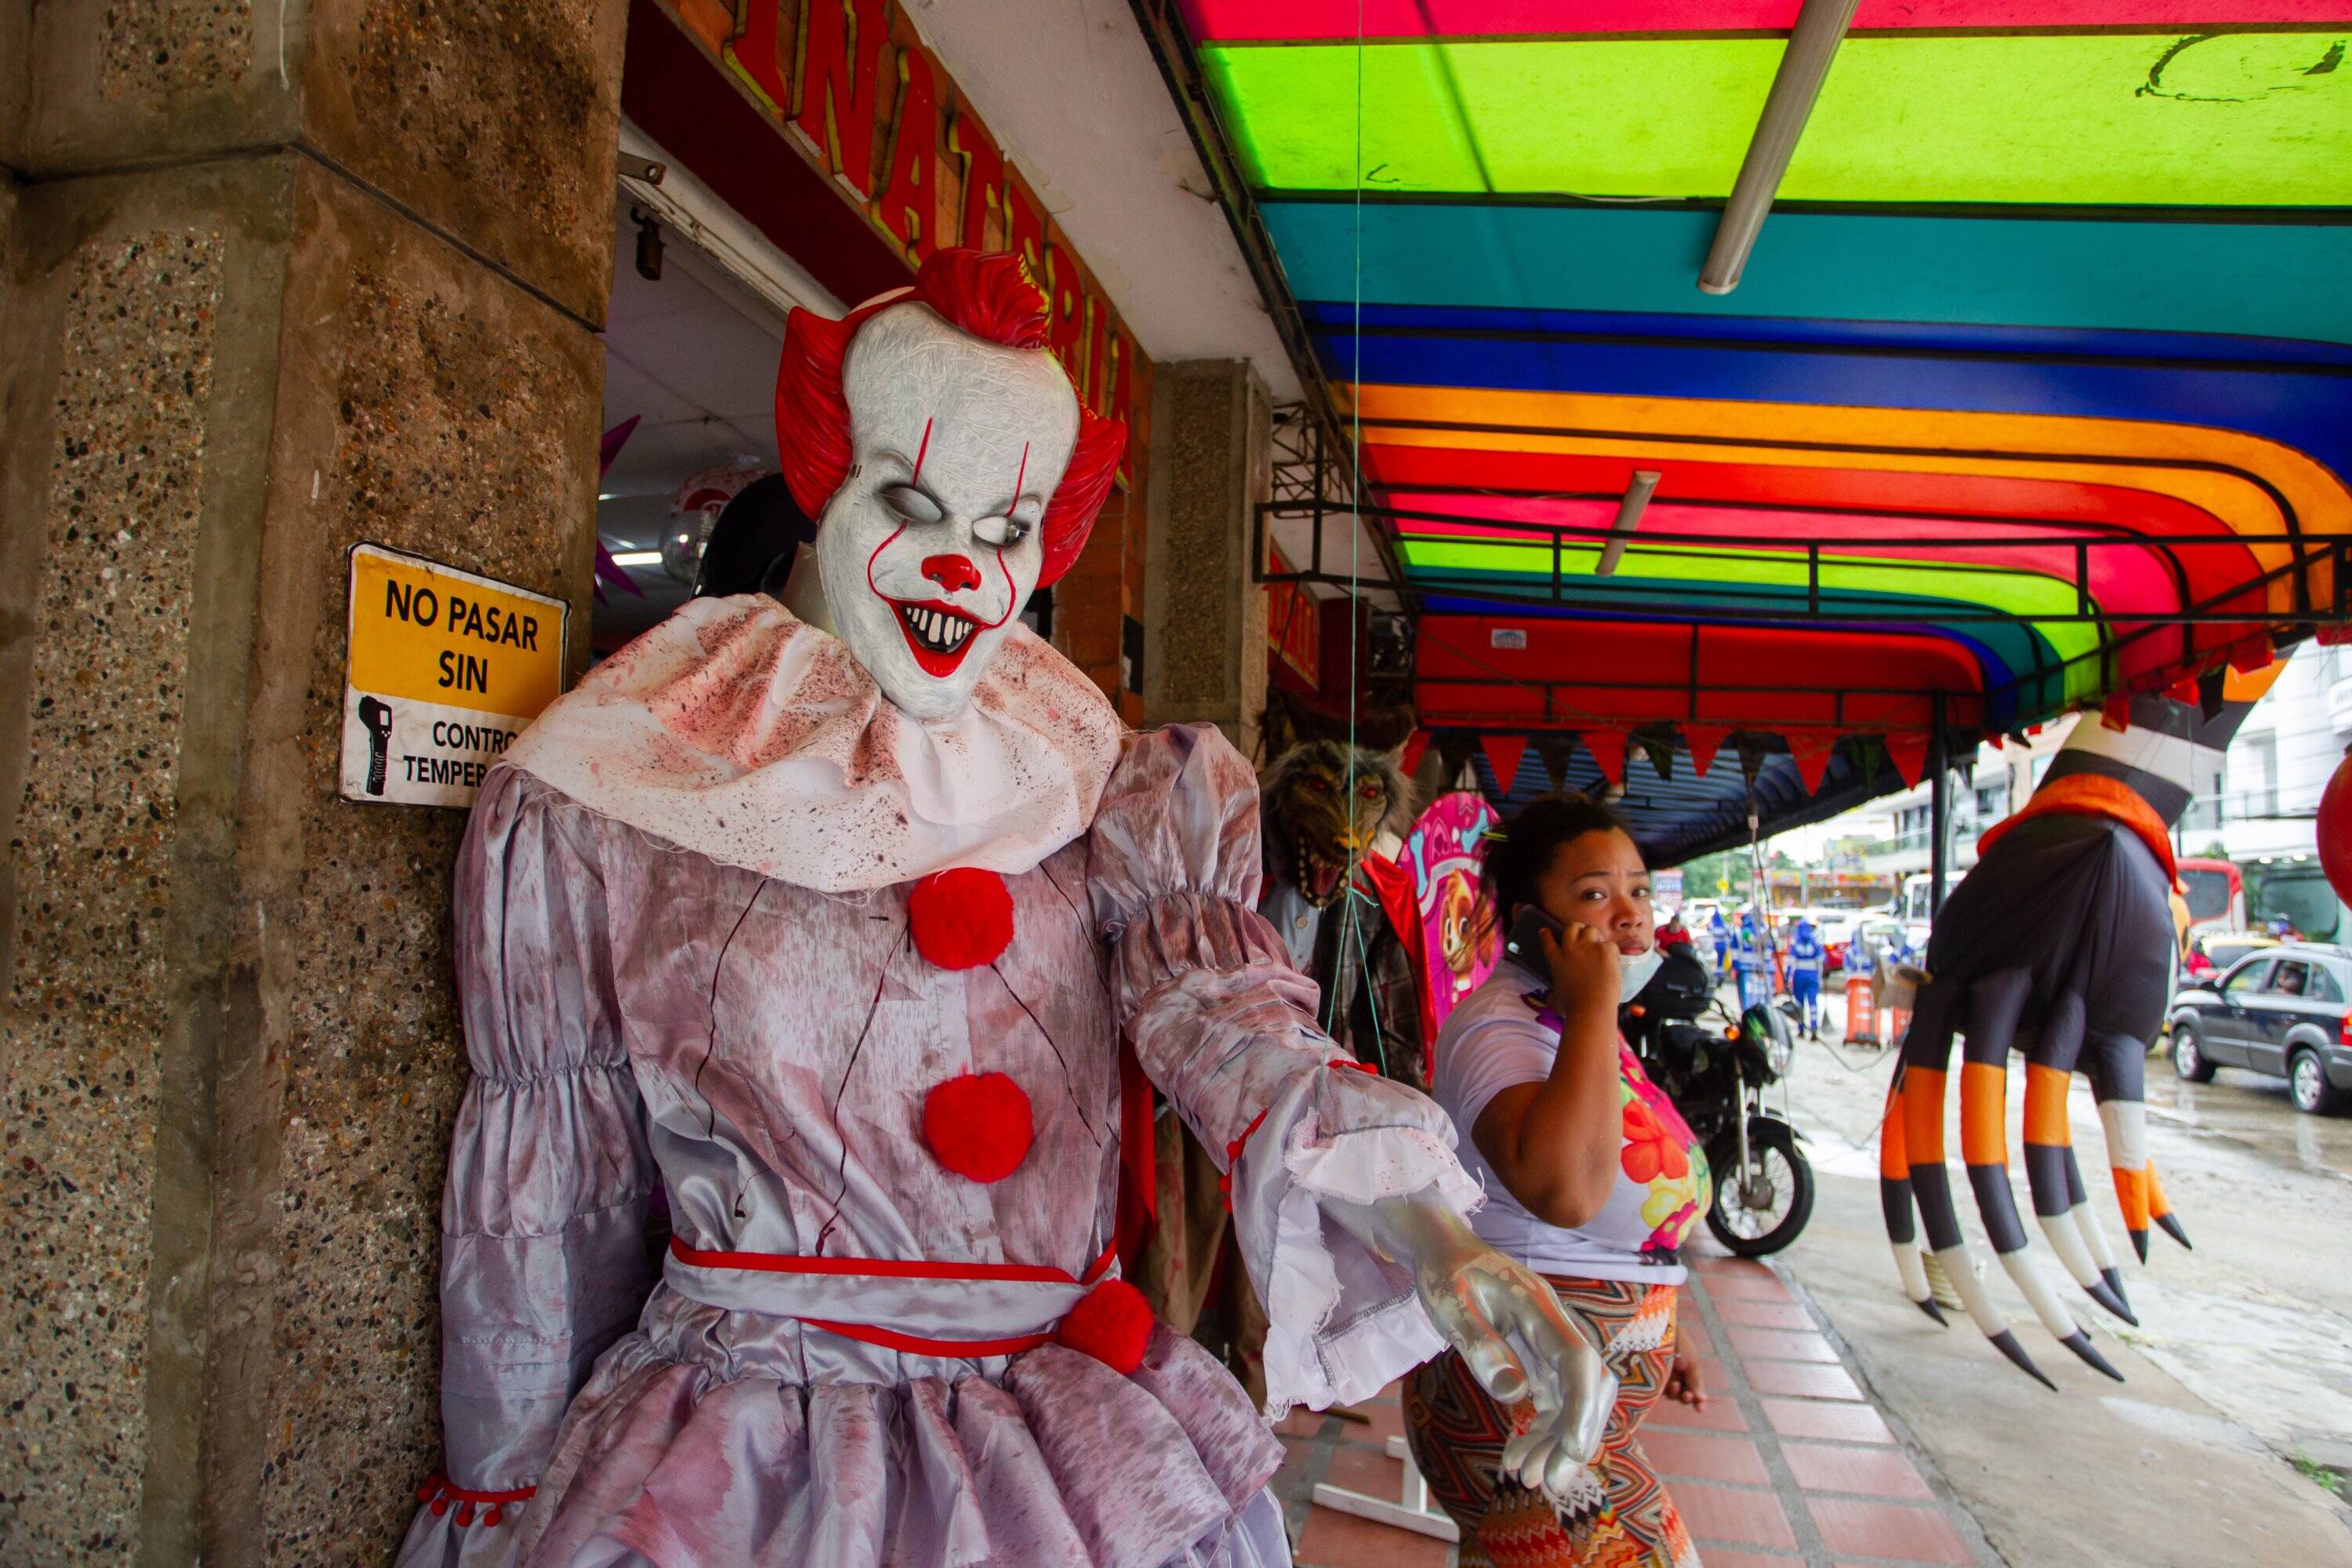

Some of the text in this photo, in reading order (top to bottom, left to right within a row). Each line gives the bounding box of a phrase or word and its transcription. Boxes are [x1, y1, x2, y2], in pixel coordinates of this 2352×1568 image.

[385, 579, 539, 652] NO PASAR
[437, 649, 488, 693] SIN
